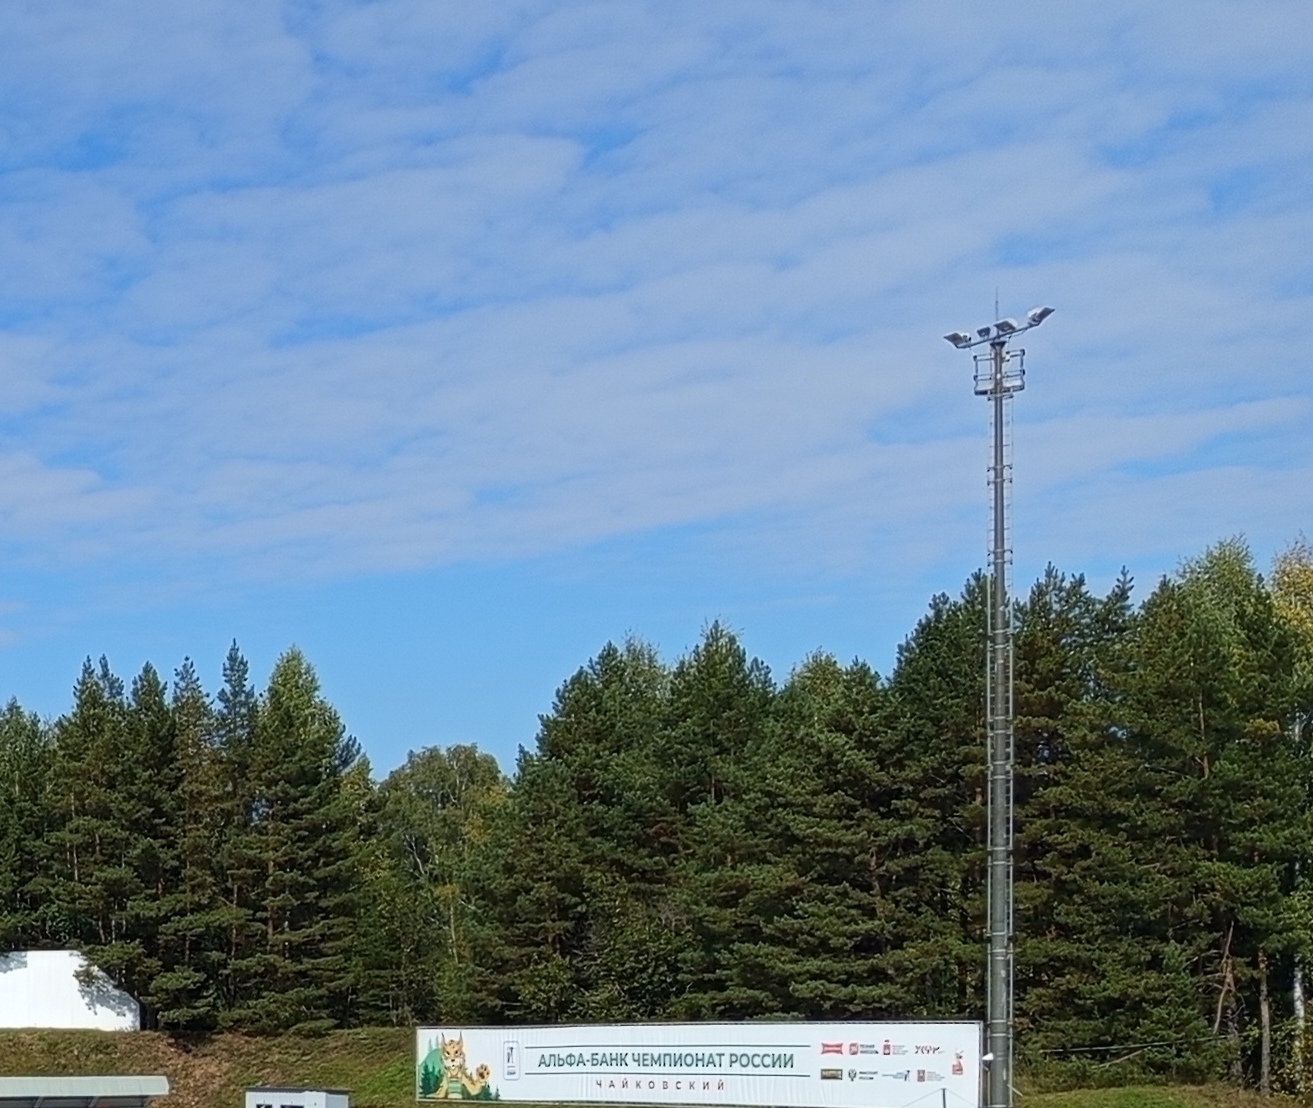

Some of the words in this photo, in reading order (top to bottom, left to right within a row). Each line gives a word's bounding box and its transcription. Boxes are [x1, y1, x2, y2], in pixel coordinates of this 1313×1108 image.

[538, 1052, 629, 1068] АЛЬФА-БАНК
[632, 1052, 726, 1068] ЧЕМПИОНАТ
[728, 1054, 795, 1069] РОССИИ
[596, 1079, 726, 1091] ЧАЙКОВСКИЙ
